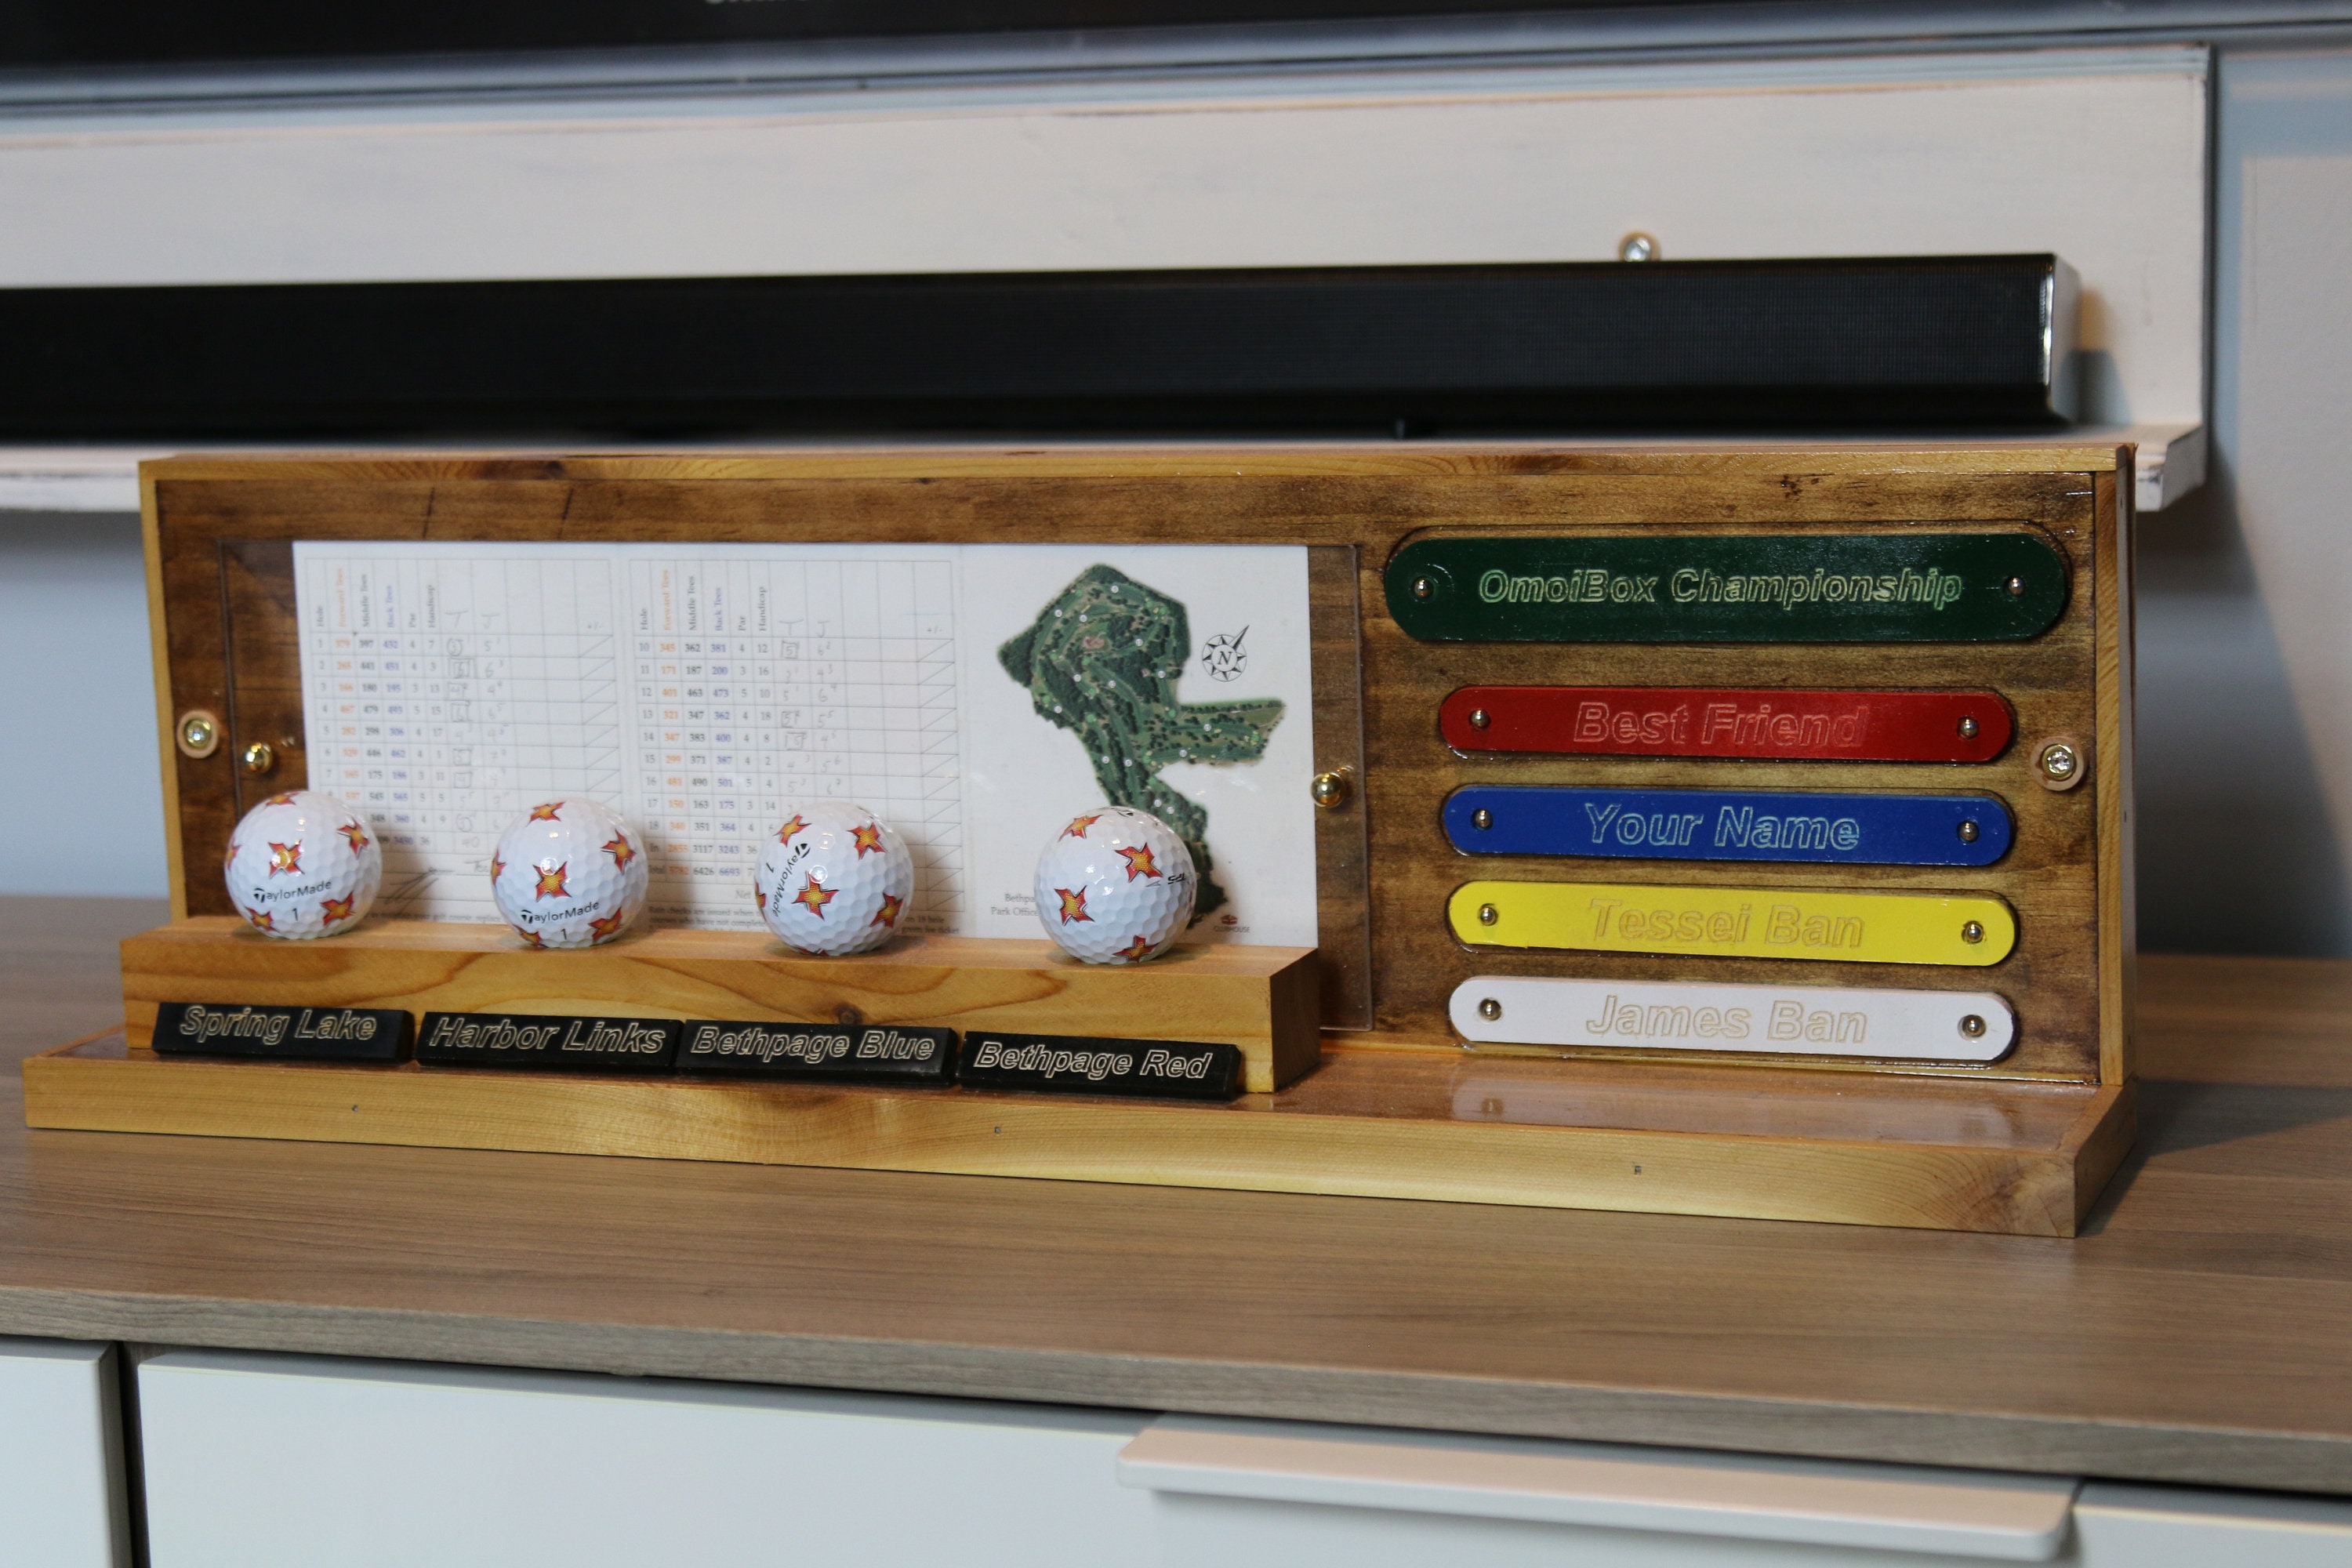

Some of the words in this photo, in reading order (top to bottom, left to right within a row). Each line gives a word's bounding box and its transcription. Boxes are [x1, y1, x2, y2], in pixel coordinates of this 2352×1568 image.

[1479, 566, 1656, 604] OmoiBox
[1671, 568, 1963, 611] Championship
[427, 585, 436, 628] Handicap
[759, 586, 768, 632] Handicap
[639, 643, 650, 652] 10
[685, 644, 701, 653] 362
[711, 644, 726, 653] 381
[739, 644, 745, 653] 4
[758, 644, 768, 653] 12
[1218, 651, 1233, 665] N
[641, 666, 650, 674] 11
[686, 666, 701, 675] 187
[711, 667, 728, 675] 200
[740, 666, 746, 675] 3
[759, 667, 769, 676] 16
[387, 684, 402, 692] 195
[430, 684, 439, 693] 13
[641, 687, 652, 697] 12
[687, 688, 703, 697] 463
[713, 689, 729, 697] 473
[741, 689, 747, 697] 5
[760, 689, 770, 699] 10
[431, 706, 441, 715] 15
[642, 710, 652, 719] 13
[688, 711, 704, 720] 347
[714, 711, 730, 720] 362
[742, 711, 748, 720] 4
[760, 711, 771, 721] 18
[1573, 700, 1688, 746] Best
[1701, 702, 1868, 747] Friend
[644, 731, 654, 740] 14
[690, 733, 705, 742] 383
[715, 734, 731, 742] 400
[744, 734, 750, 743] 4
[764, 734, 770, 743] 8
[644, 755, 655, 764] 15
[691, 756, 706, 764] 371
[717, 757, 732, 765] 387
[745, 757, 750, 765] 4
[765, 757, 771, 766] 2
[368, 771, 383, 779] 175
[646, 777, 657, 786] 16
[691, 778, 708, 787] 490
[717, 779, 733, 788] 501
[746, 779, 752, 788] 5
[766, 779, 772, 788] 4
[647, 799, 657, 808] 17
[693, 800, 709, 809] 163
[719, 801, 735, 809] 175
[747, 801, 753, 810] 3
[765, 801, 776, 810] 14
[649, 821, 659, 830] 18
[694, 823, 710, 831] 351
[720, 823, 736, 832] 364
[748, 823, 753, 832] 4
[1584, 802, 1703, 849] Your
[1714, 805, 1860, 851] Name
[693, 845, 713, 853] 3117
[718, 845, 740, 854] 3243
[747, 846, 758, 854] 36
[693, 867, 715, 876] 6426
[719, 868, 740, 877] 6693
[766, 862, 775, 873] 1
[772, 843, 811, 917] TaylorMade
[253, 880, 332, 903] TaylorMade
[735, 890, 751, 899] Net
[1005, 893, 1035, 905] Bethpa
[292, 908, 298, 921] 1
[521, 901, 600, 924] TaylorMade
[991, 907, 1011, 916] Park
[1588, 898, 1751, 945] Tessei
[1766, 904, 1864, 949] Ban
[560, 928, 568, 939] 1
[180, 1004, 287, 1045] Spring
[296, 1009, 377, 1040] Lake
[1585, 994, 1750, 1040] James
[1769, 1000, 1867, 1044] Ban
[430, 1018, 558, 1051] Harbor
[562, 1021, 665, 1055] Links
[691, 1025, 849, 1063] Bethpage
[856, 1030, 935, 1062] Blue
[974, 1041, 1133, 1080] Bethpage
[1139, 1048, 1212, 1080] Red
